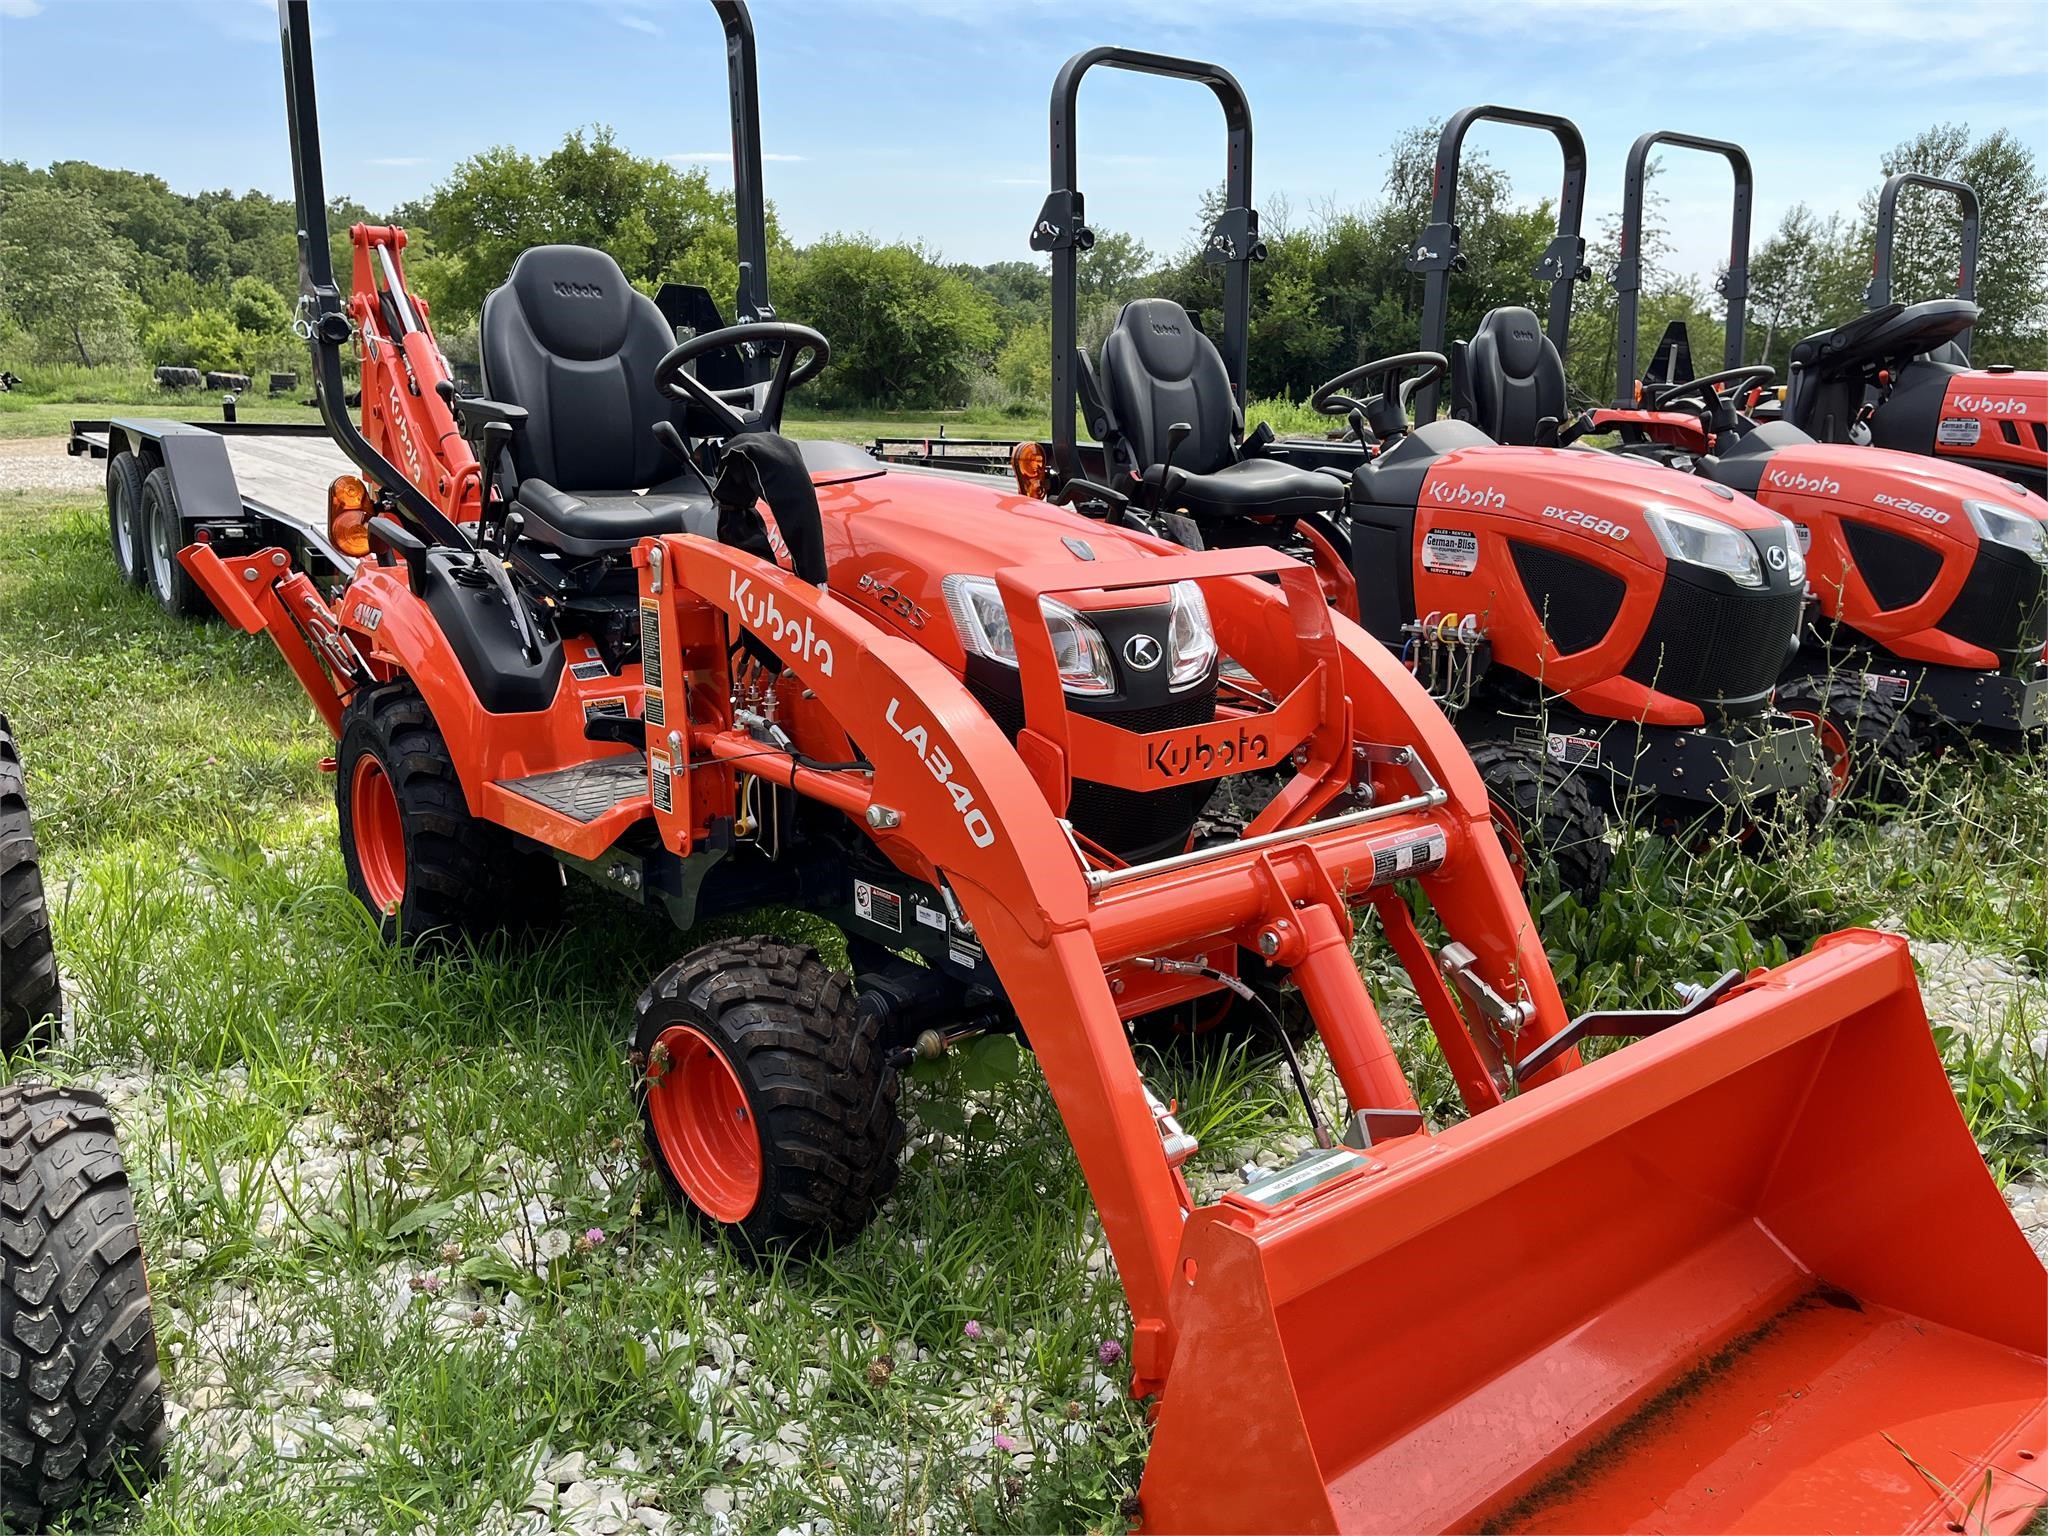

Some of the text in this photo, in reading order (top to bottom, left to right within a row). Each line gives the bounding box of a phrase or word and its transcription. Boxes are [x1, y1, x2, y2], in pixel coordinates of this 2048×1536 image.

[552, 281, 603, 299] Kubota
[1954, 395, 2027, 414] Kubota
[389, 386, 421, 483] Kubota
[1429, 480, 1506, 508] Kubota
[1769, 469, 1841, 494] Kubota
[1542, 505, 1630, 541] BX2680
[1872, 493, 1951, 524] BX2680
[1427, 535, 1476, 550] German-Bliss
[352, 603, 383, 631] 4WD
[857, 573, 932, 631] BX23S
[728, 570, 833, 677] Kubota
[1147, 726, 1269, 778] Kubota
[885, 697, 995, 848] LA340
